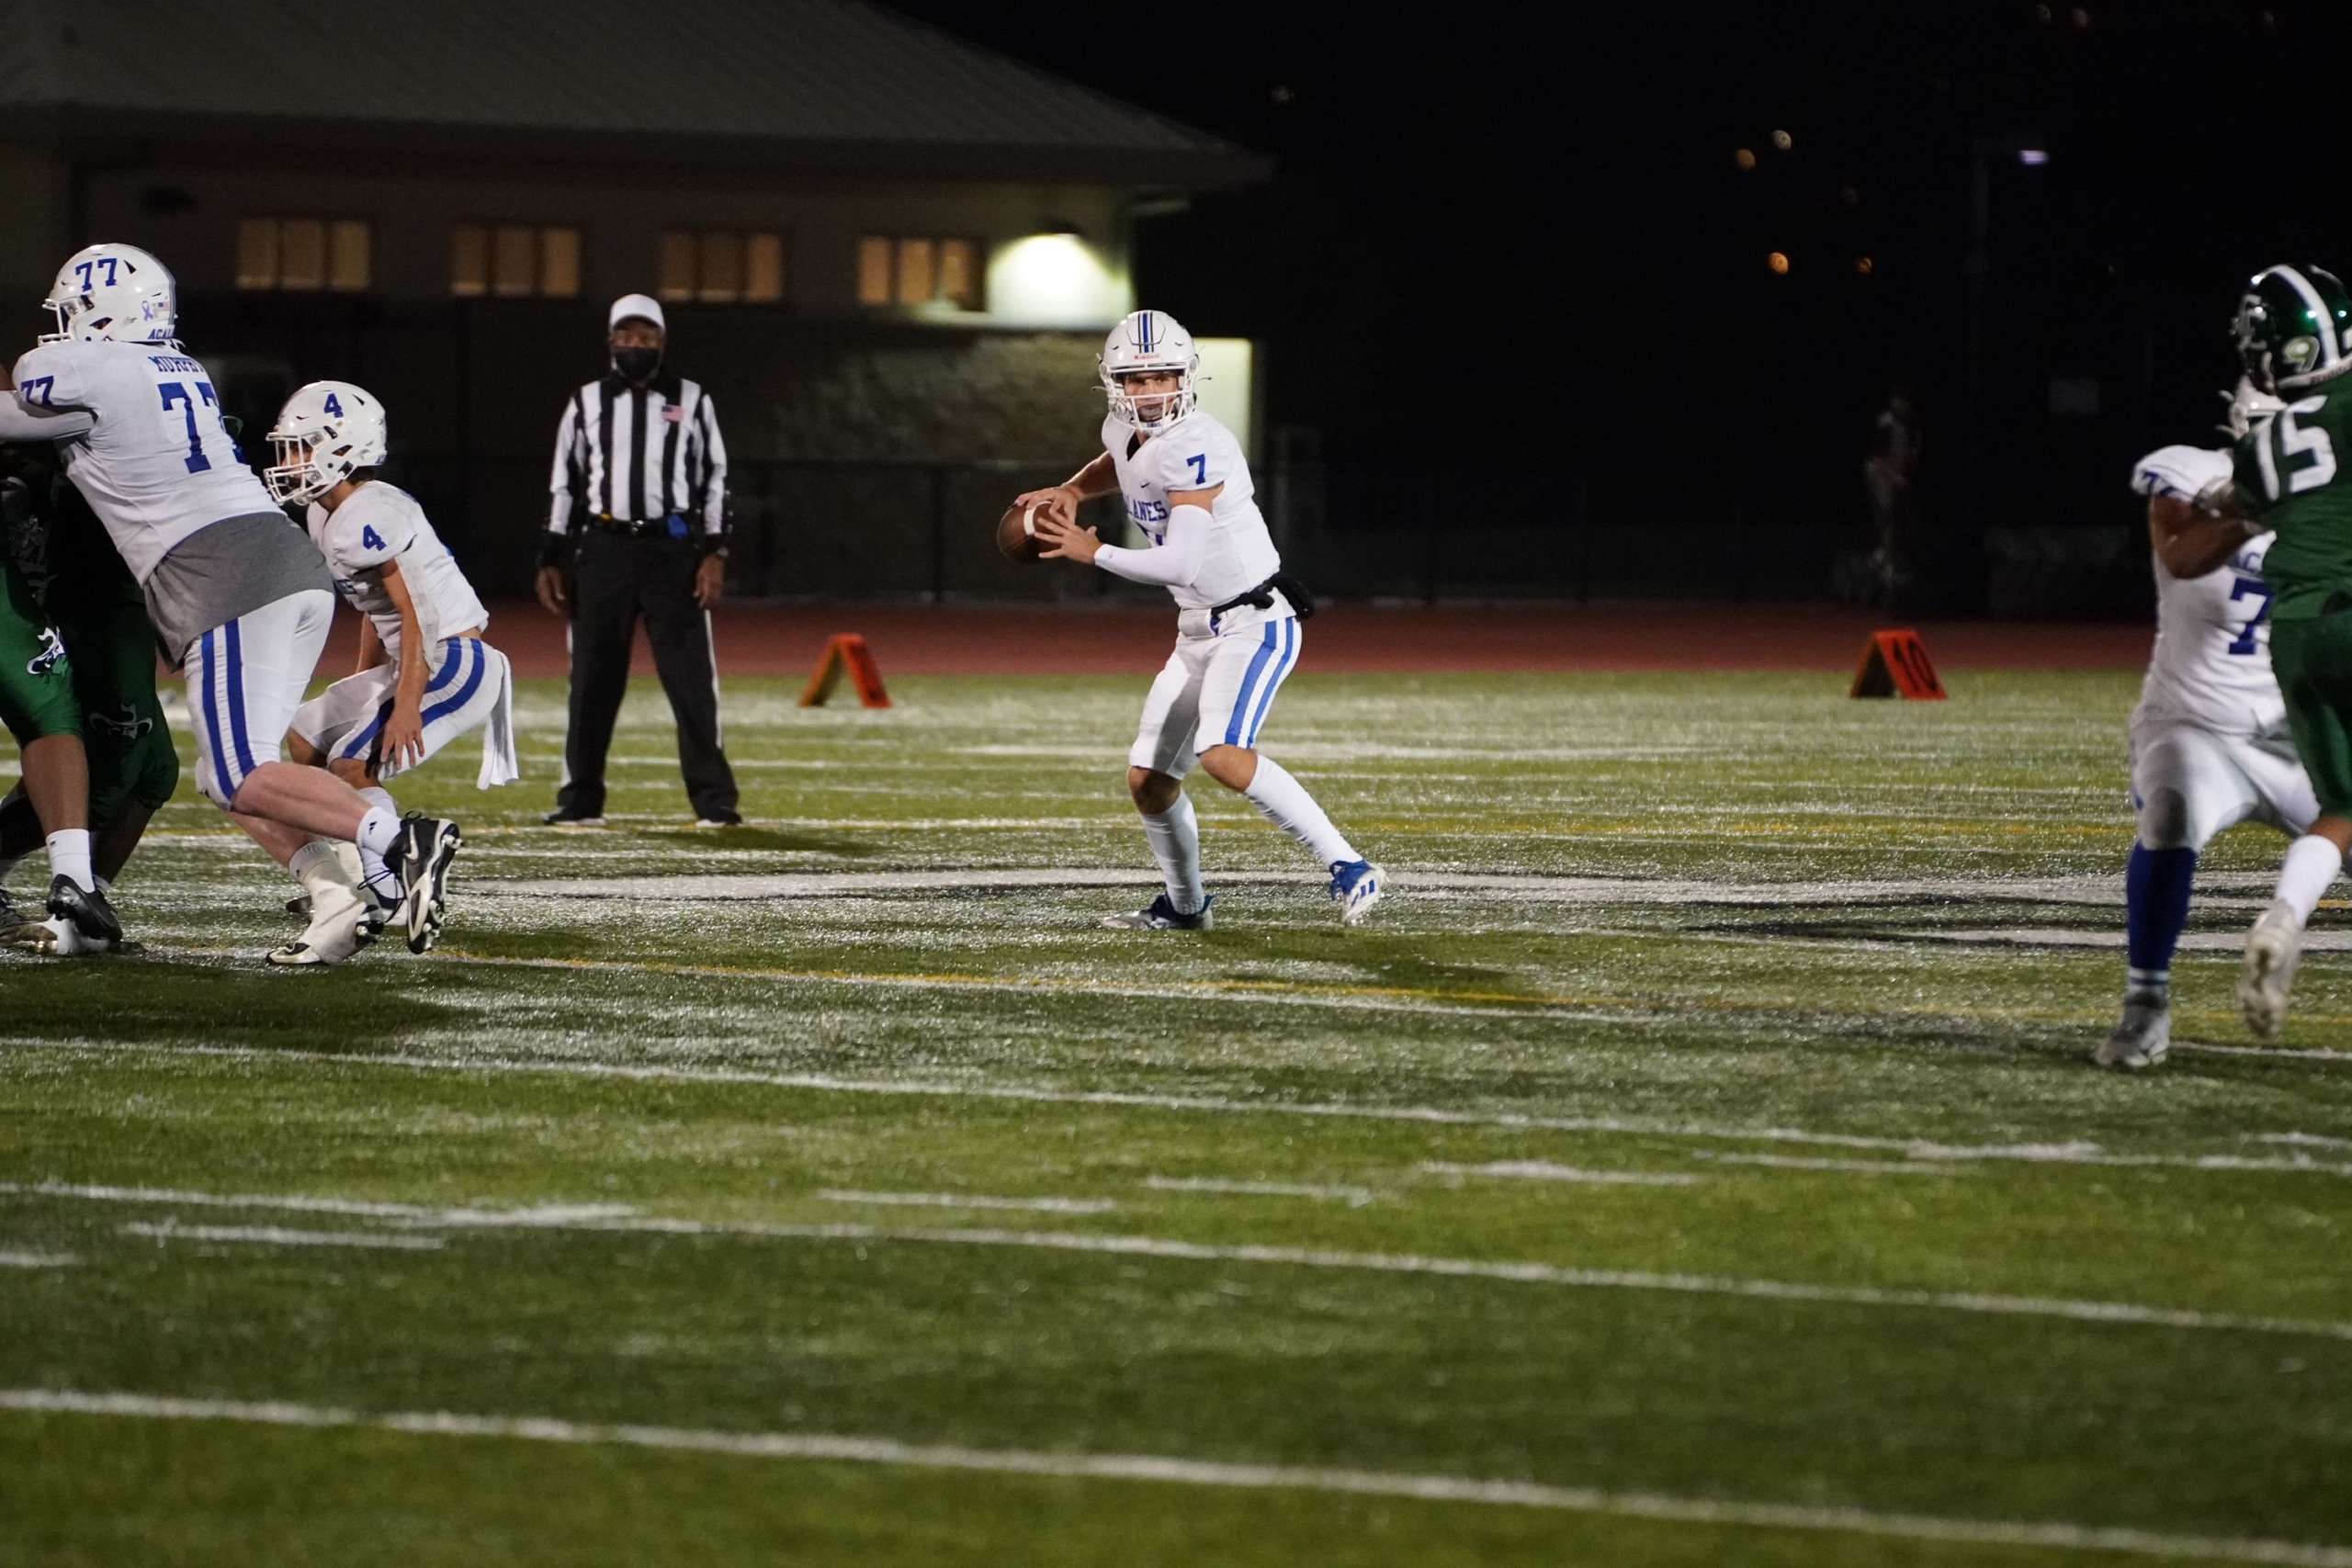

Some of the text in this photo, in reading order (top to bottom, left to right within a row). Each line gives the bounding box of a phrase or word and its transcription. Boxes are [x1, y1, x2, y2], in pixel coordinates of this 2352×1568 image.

[75, 257, 118, 292] 77
[21, 375, 54, 406] 77
[323, 392, 344, 418] 4
[2256, 394, 2337, 501] 15
[1186, 454, 1206, 485] 7
[362, 524, 387, 551] 4
